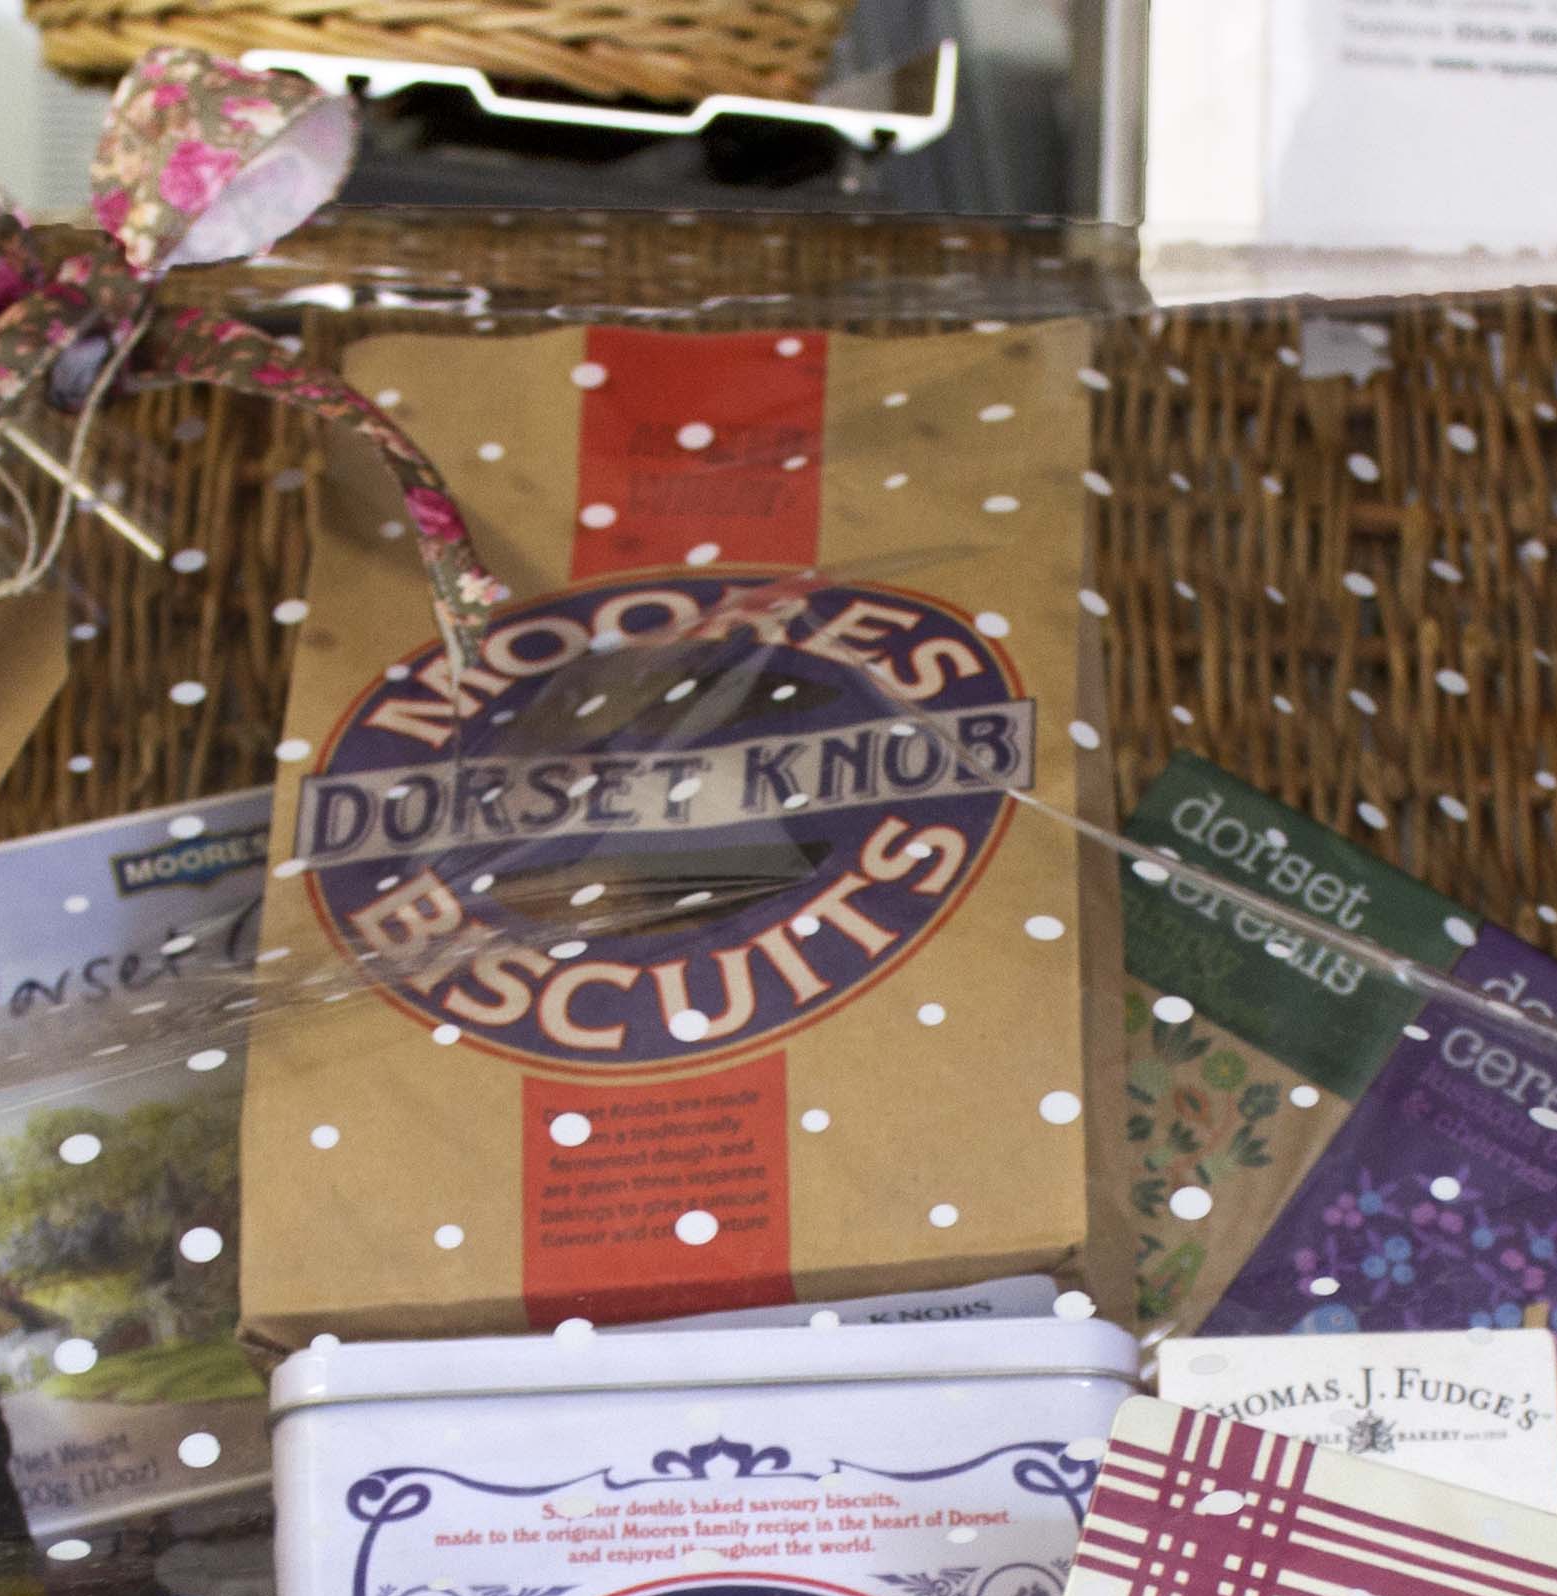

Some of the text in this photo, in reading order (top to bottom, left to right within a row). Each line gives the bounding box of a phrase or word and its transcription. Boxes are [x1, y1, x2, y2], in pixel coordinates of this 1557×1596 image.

[363, 583, 986, 749] MOORES
[311, 712, 1023, 858] DORSET KNOB
[1171, 792, 1370, 930] dorset
[349, 815, 969, 1051] BISCUITS
[1200, 1378, 1341, 1421] HOMAS
[434, 1508, 1010, 1547] made to the original Moores family recipe in the heart of Dorset
[568, 1547, 601, 1565] and
[606, 1543, 676, 1565] enjoyed
[785, 1539, 813, 1556] the
[626, 1499, 686, 1518] double
[691, 1497, 743, 1515] baked
[749, 1498, 819, 1514] savoury
